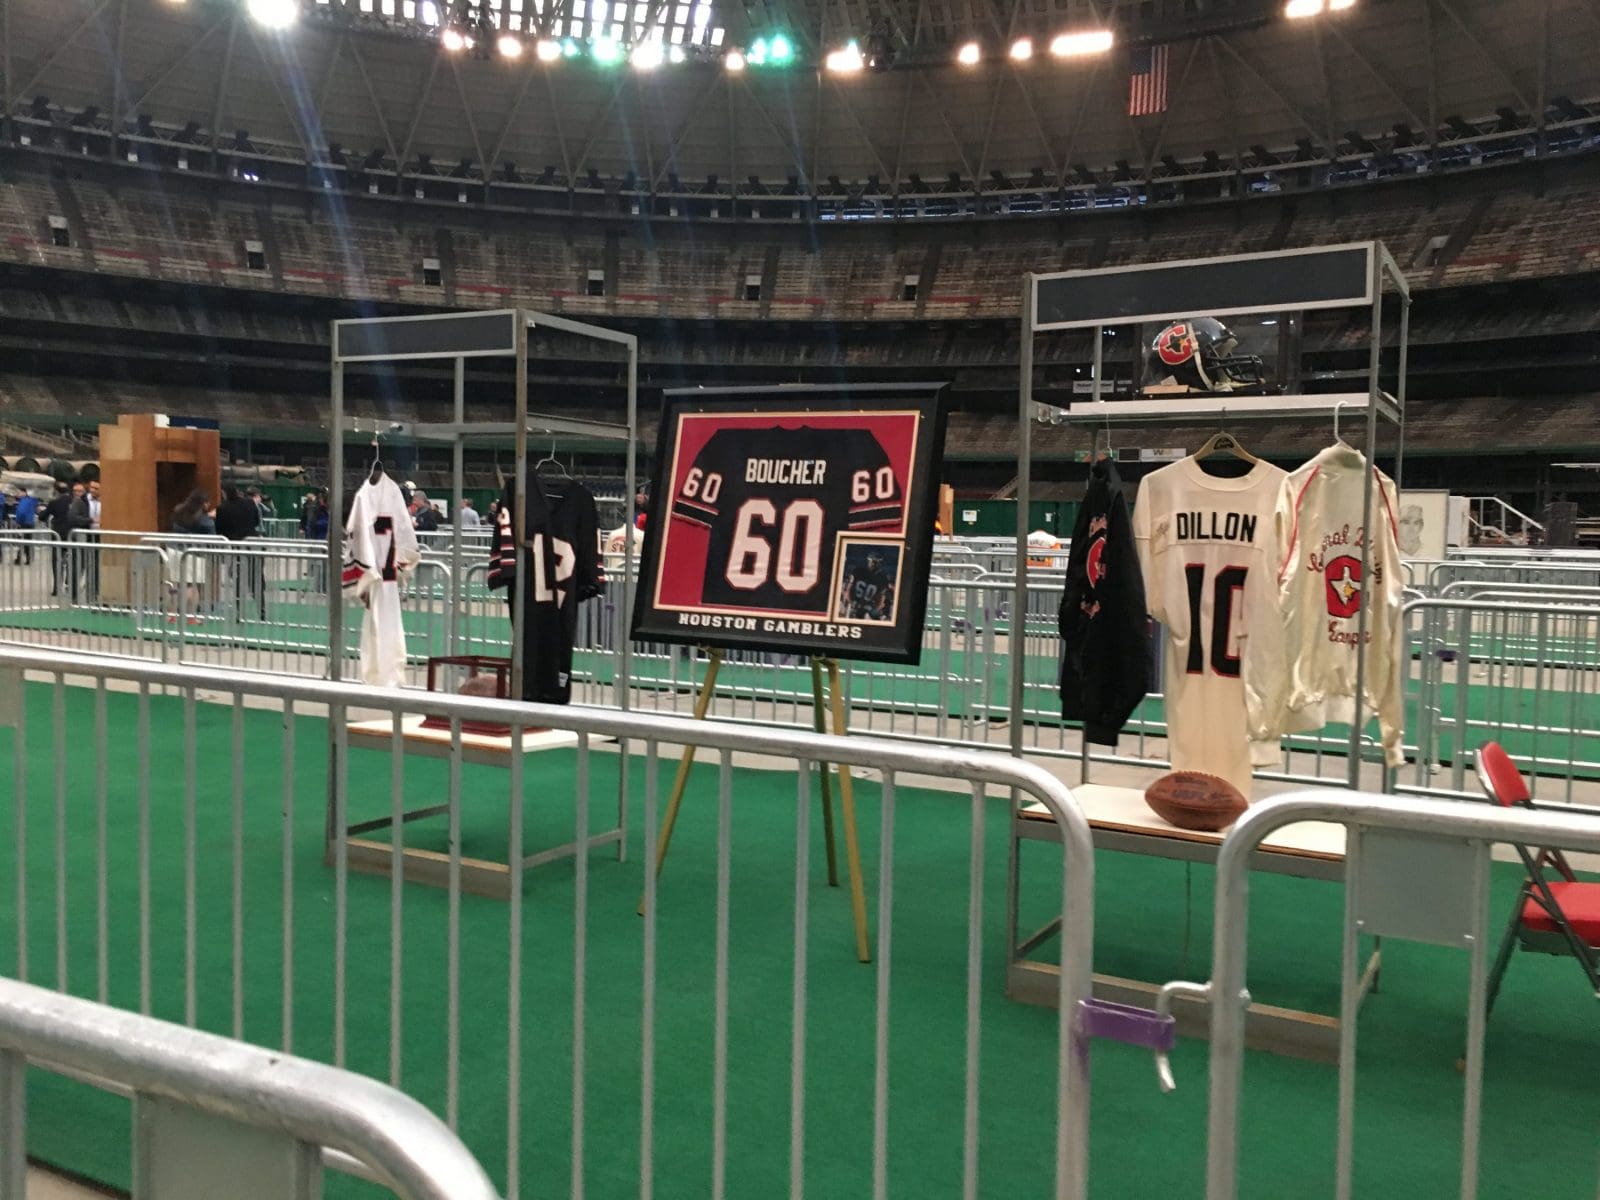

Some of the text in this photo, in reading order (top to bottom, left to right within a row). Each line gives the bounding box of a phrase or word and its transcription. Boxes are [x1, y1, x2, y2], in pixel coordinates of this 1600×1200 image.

[682, 467, 722, 504] 60
[745, 458, 826, 484] BOUCHER
[852, 466, 894, 503] 60
[725, 498, 825, 594] 60
[1176, 512, 1257, 543] DILLON
[678, 613, 863, 639] HOUSTON GAMBLERS
[1185, 563, 1249, 678] 10
